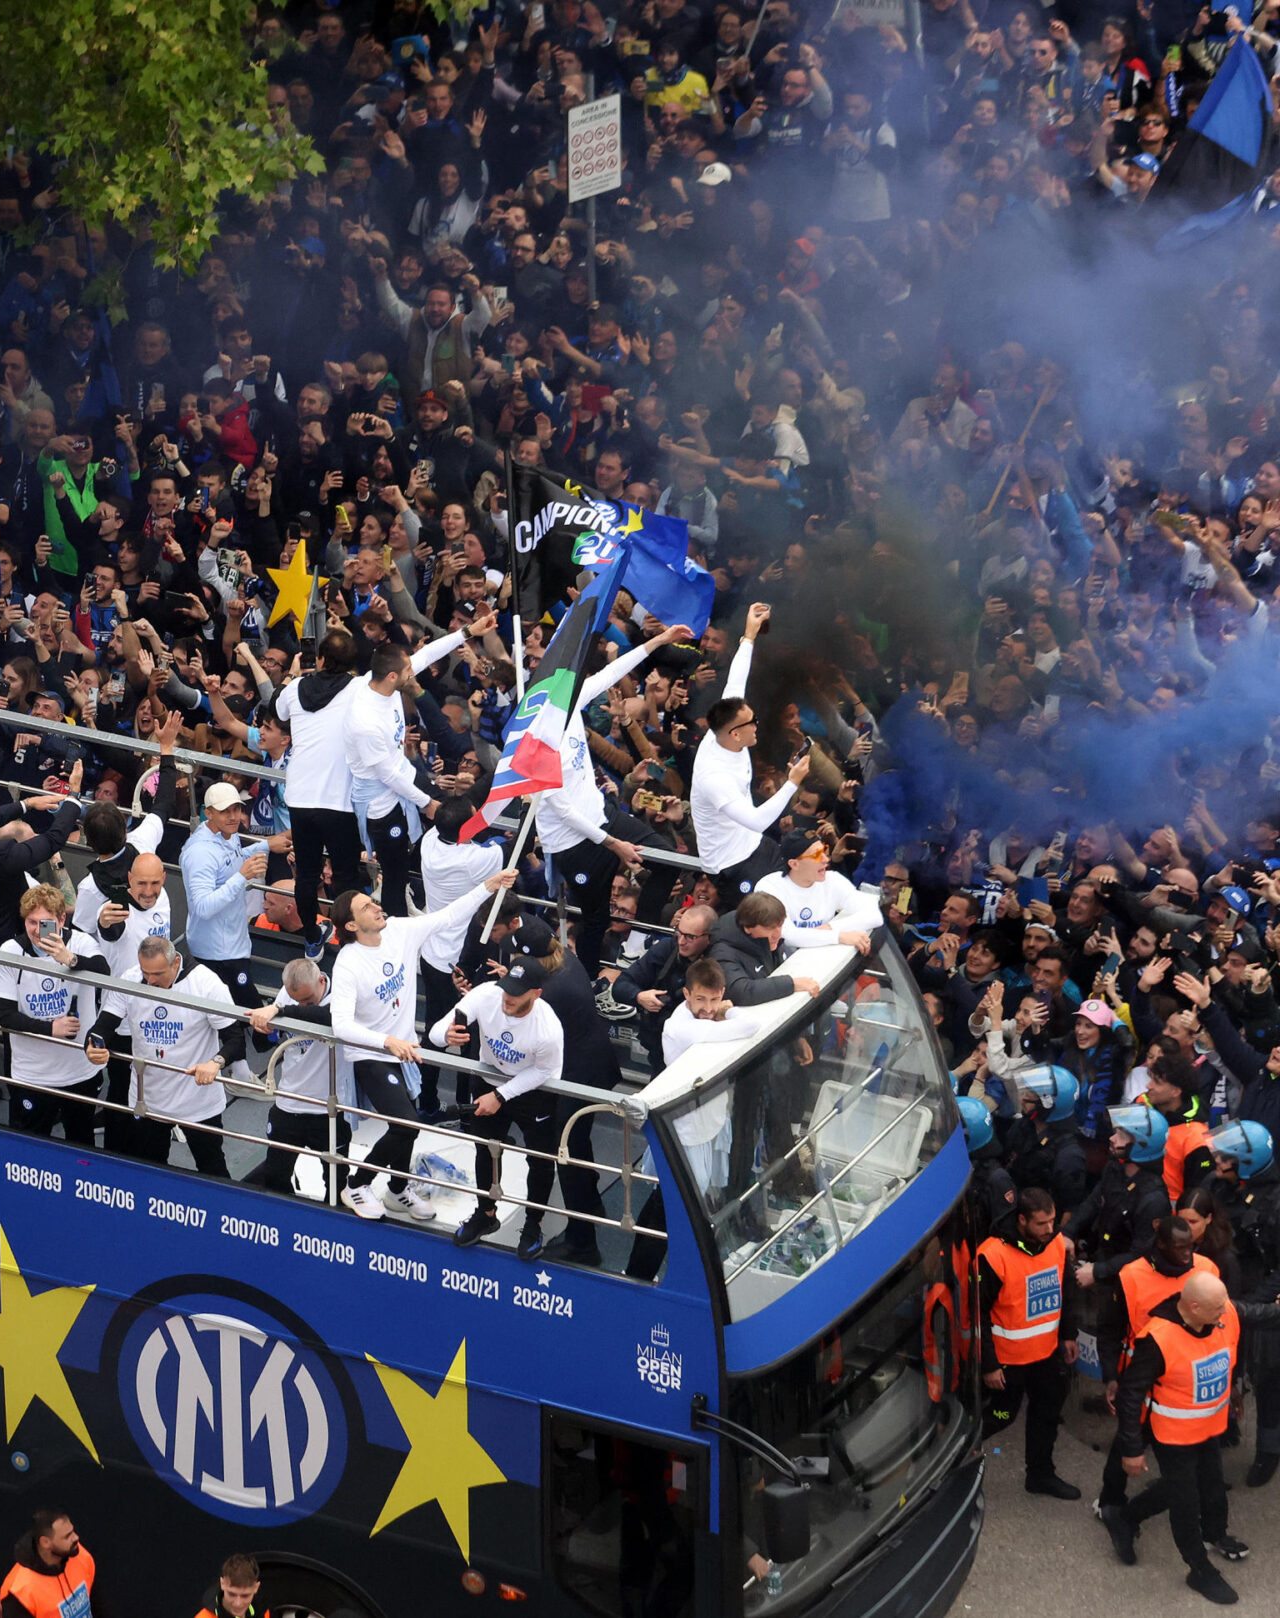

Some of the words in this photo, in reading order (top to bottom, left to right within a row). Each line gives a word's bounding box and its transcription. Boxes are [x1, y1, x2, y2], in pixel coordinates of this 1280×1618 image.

[29, 1000, 66, 1012] D'ITALIA
[33, 1008, 64, 1018] 2023/2024
[139, 1020, 183, 1032] CAMPIONI
[144, 1030, 179, 1041] D'ITALIA
[4, 1162, 62, 1193] 1988/89
[75, 1179, 135, 1211] 2005/06
[148, 1197, 207, 1230] 2006/07
[221, 1214, 279, 1247] 2007/08
[292, 1232, 355, 1265] 2008/09
[367, 1250, 427, 1284] 2009/10
[441, 1268, 500, 1301] 2020/21
[1029, 1272, 1060, 1294] STEWARD
[512, 1285, 573, 1318] 2023/24
[1030, 1293, 1059, 1313] 0143
[637, 1343, 682, 1367] MILAN
[637, 1356, 682, 1380] OPEN
[637, 1368, 681, 1391] TOUR
[1198, 1356, 1230, 1380] STEWARD
